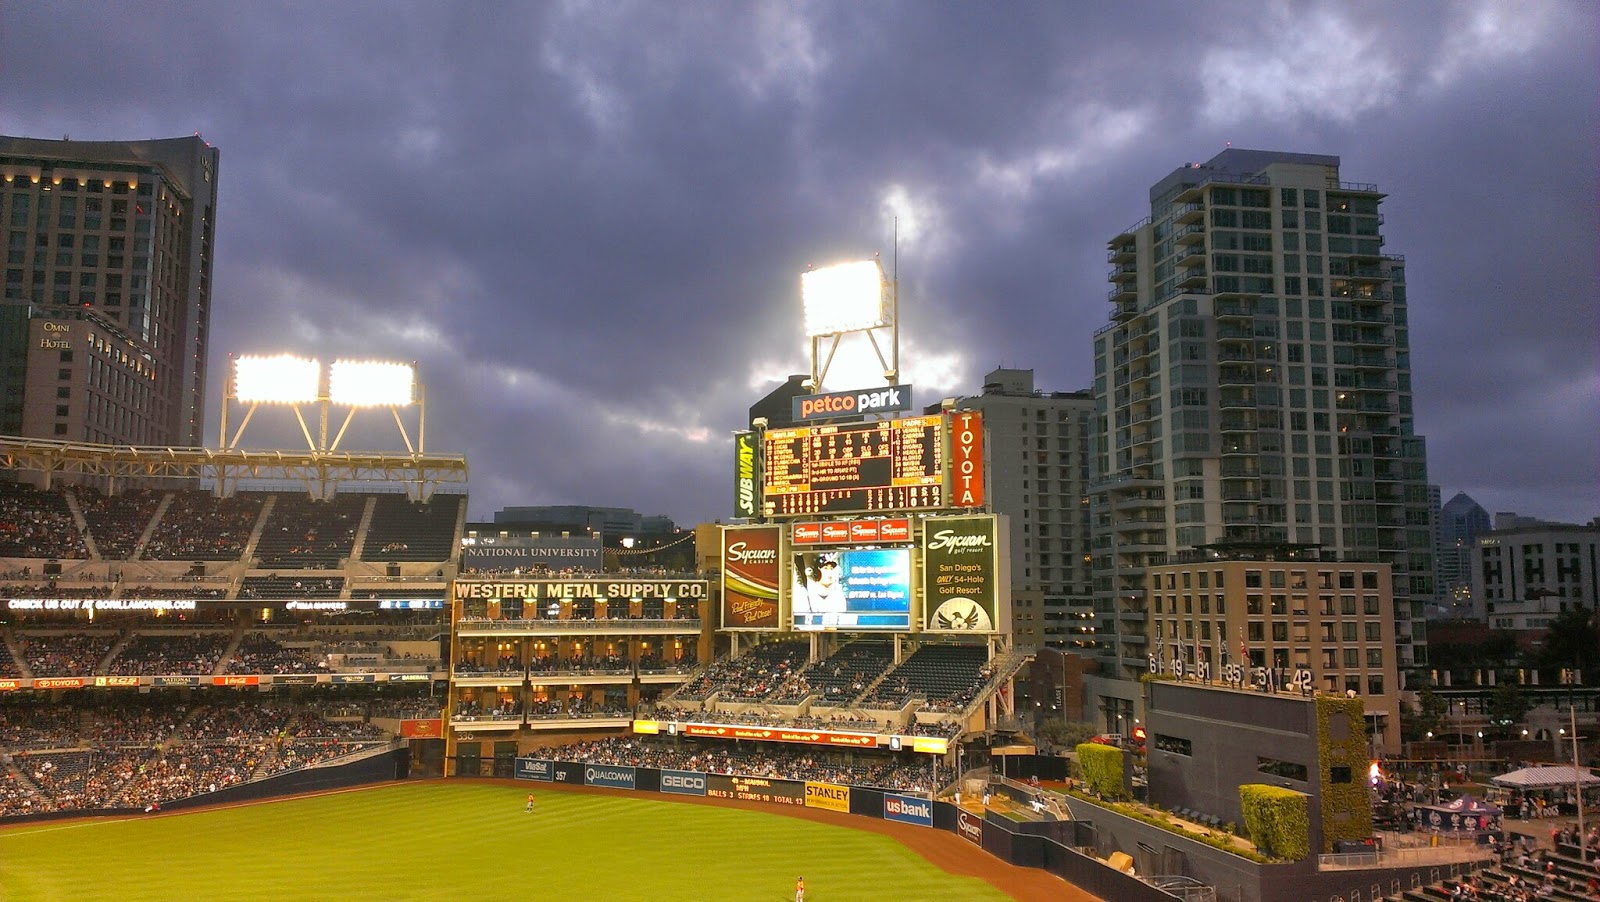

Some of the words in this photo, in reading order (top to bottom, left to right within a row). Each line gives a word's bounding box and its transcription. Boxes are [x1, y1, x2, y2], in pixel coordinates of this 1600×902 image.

[43, 322, 70, 332] OMNI
[40, 338, 71, 349] HOTEL
[802, 396, 855, 418] petco
[858, 388, 900, 412] park
[960, 416, 974, 504] TOYOTA
[740, 436, 754, 516] SUBWAY
[933, 496, 940, 506] 2
[928, 529, 992, 554] Sycuan
[468, 548, 527, 557] NATIONAL
[531, 548, 599, 557] UNIVERSITY
[728, 542, 776, 565] Sycuan
[955, 564, 982, 572] Diego's
[456, 583, 538, 598] WESTERN
[546, 583, 603, 598] METAL
[608, 583, 675, 598] SUPPLY
[678, 584, 706, 598] CO.
[8, 600, 43, 609] CHECK
[60, 600, 80, 609] OUT
[81, 600, 94, 609] AT
[1150, 658, 1156, 673] 6
[1171, 659, 1182, 676] 19
[1198, 662, 1210, 678] 31
[1225, 664, 1241, 682] 35
[1258, 667, 1273, 690] 51
[1293, 669, 1312, 689] 42
[457, 732, 473, 740] 336
[525, 761, 547, 771] ViaSat
[555, 771, 567, 780] 357
[586, 768, 633, 783] QUALCOMM
[663, 775, 704, 789] GEICO
[738, 793, 761, 801] STRIKES
[774, 795, 793, 804] TOTAL
[806, 786, 848, 800] STANLEY
